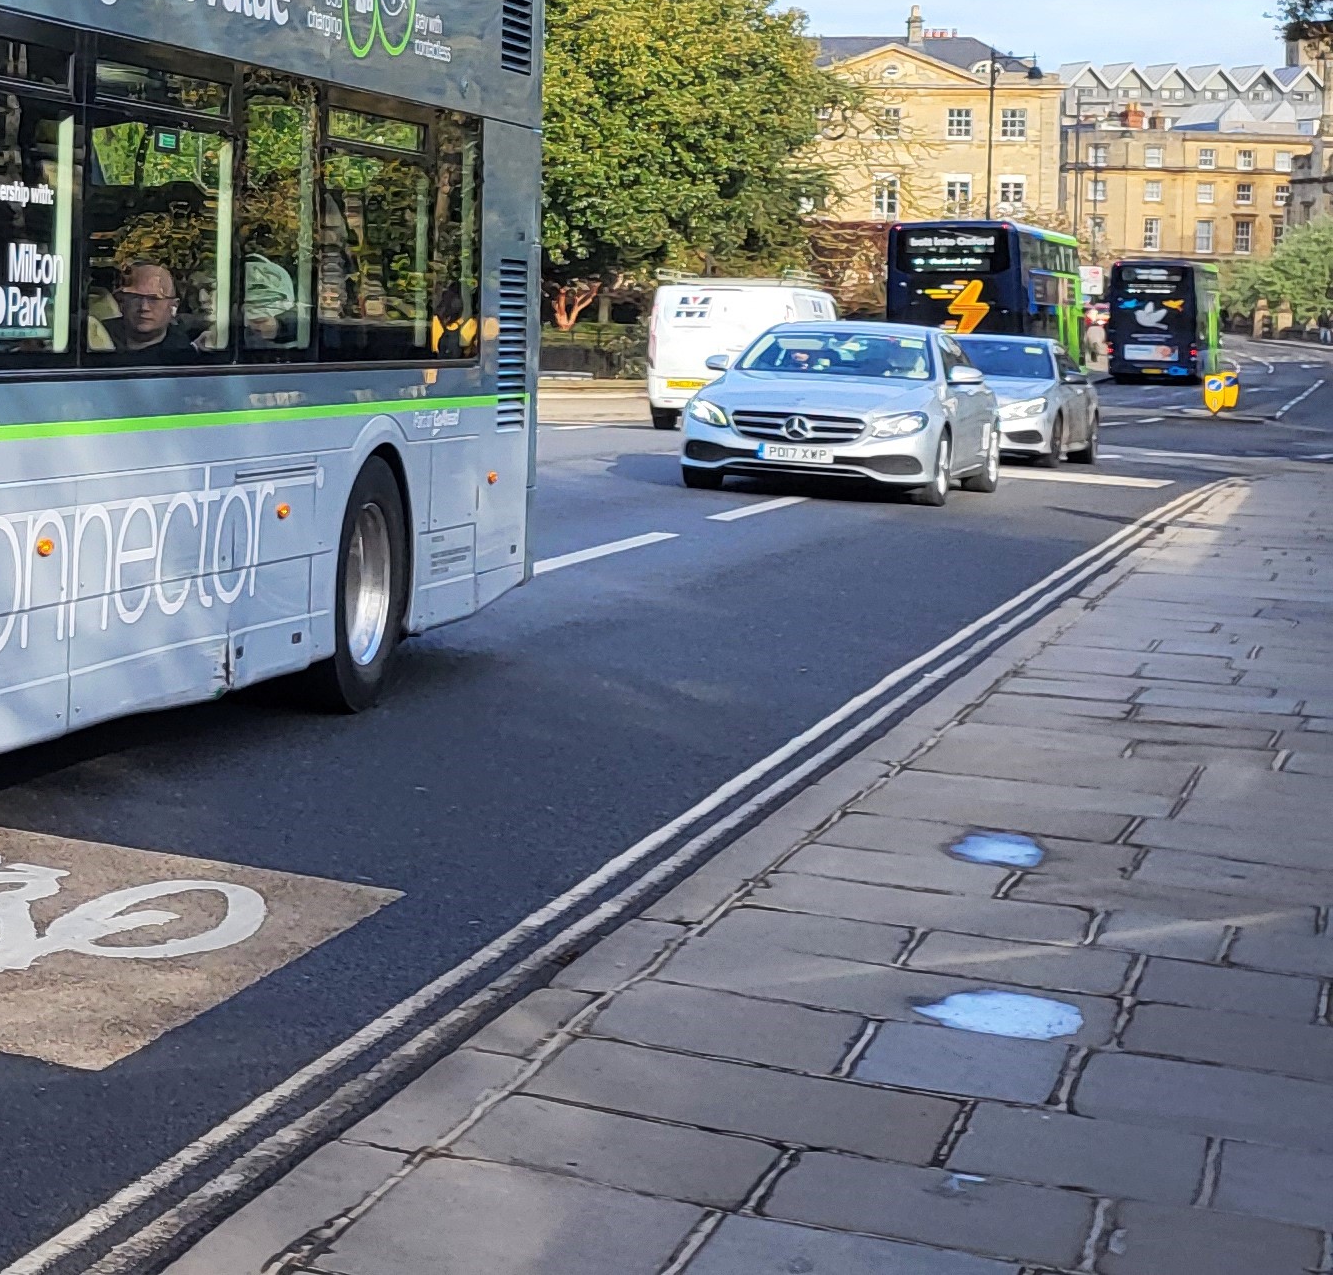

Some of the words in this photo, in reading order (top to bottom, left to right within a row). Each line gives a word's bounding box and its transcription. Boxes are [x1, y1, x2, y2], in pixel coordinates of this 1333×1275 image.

[307, 5, 343, 41] charging
[30, 183, 54, 205] with:
[7, 242, 64, 285] Milton
[6, 286, 50, 327] Park
